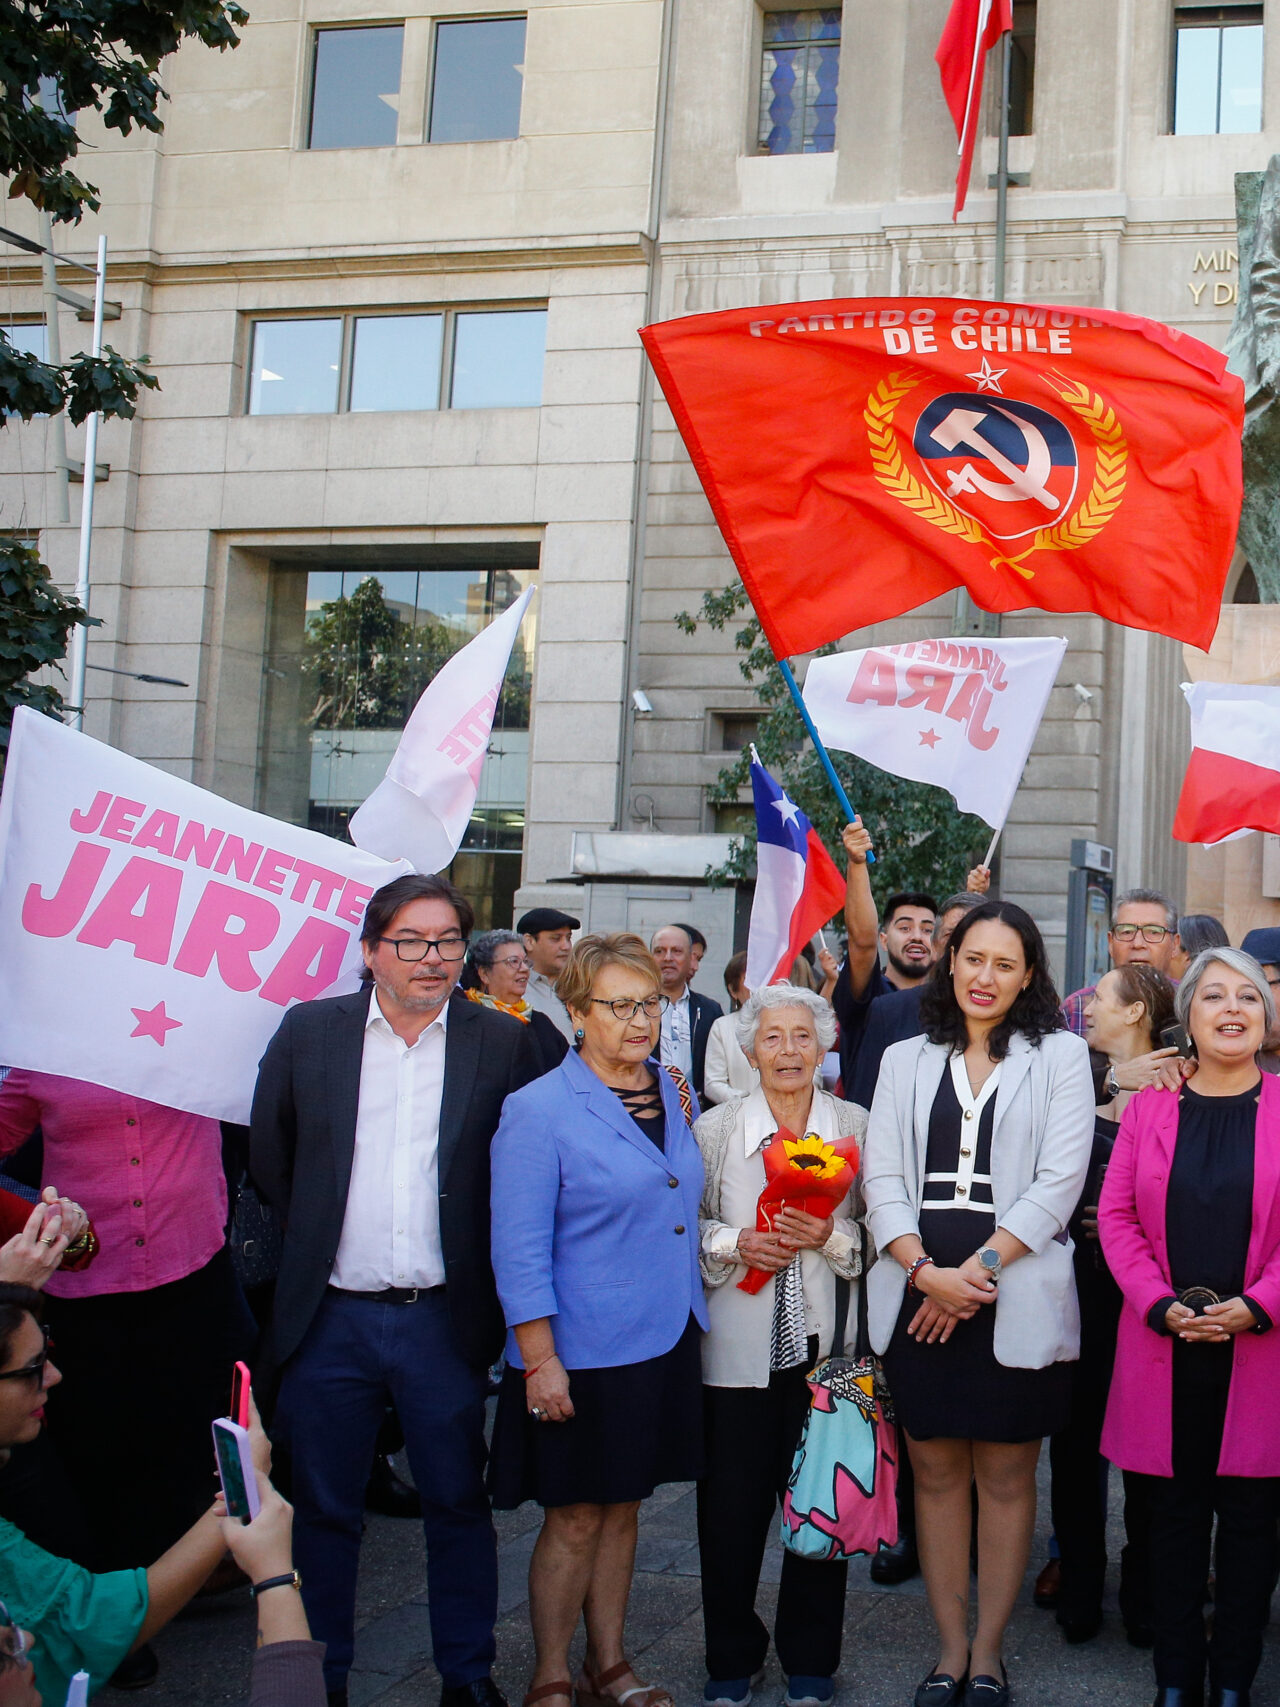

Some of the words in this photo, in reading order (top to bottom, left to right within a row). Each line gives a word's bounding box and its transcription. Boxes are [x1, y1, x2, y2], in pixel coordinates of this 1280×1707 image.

[1187, 282, 1207, 305] Y
[749, 307, 937, 338] PARTIDO
[952, 307, 1104, 329] COMUN
[883, 326, 938, 356] DE
[951, 325, 1072, 355] CHILE
[69, 790, 374, 926] JEANNETTE
[21, 840, 351, 1007] JARA
